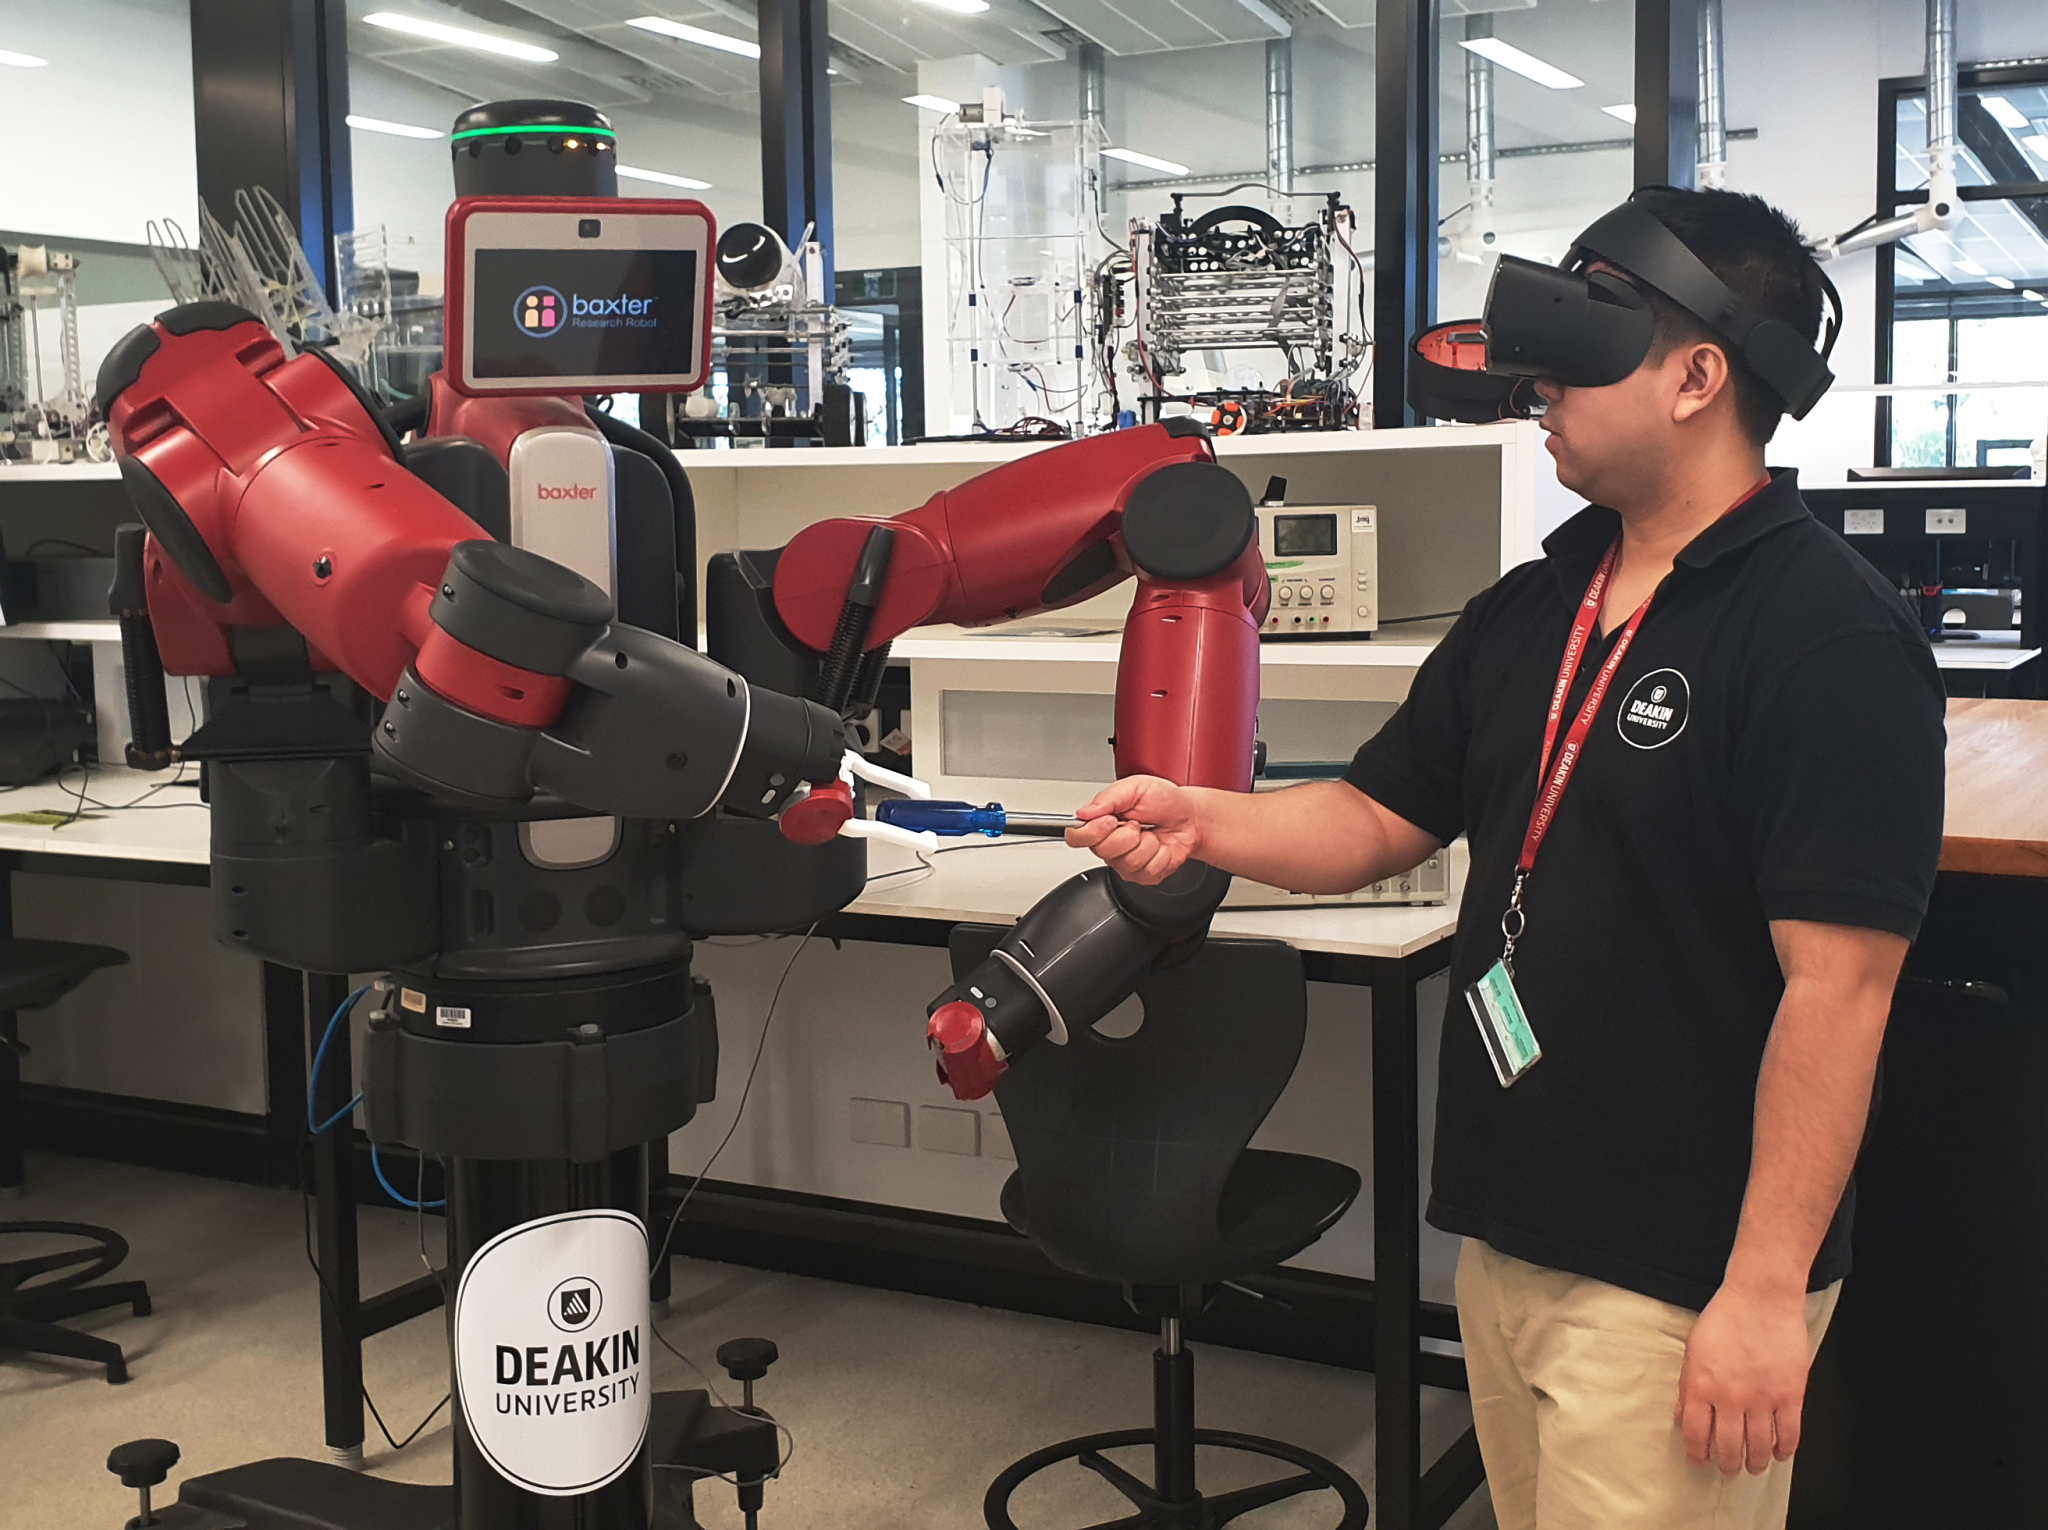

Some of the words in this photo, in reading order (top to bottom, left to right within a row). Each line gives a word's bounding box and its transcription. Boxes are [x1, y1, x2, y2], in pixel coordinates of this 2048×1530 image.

[572, 293, 653, 316] baxter
[572, 318, 623, 328] Research
[626, 317, 658, 328] Robot
[537, 483, 597, 500] baxter
[1588, 572, 1606, 600] DEAKIN
[1551, 679, 1568, 711] DEAKIN
[1561, 624, 1585, 678] UNIVERSITY
[1606, 638, 1629, 670] DEAKIN
[1580, 669, 1611, 725] UNIVERSITY
[1629, 699, 1674, 722] DEAKIN
[1626, 713, 1668, 730] UNIVERSITY
[1553, 751, 1575, 787] DEAKIN
[1531, 785, 1561, 842] UNIVERSITY
[495, 1324, 640, 1387] DEAKIN
[495, 1371, 640, 1416] UNIVERSITY
